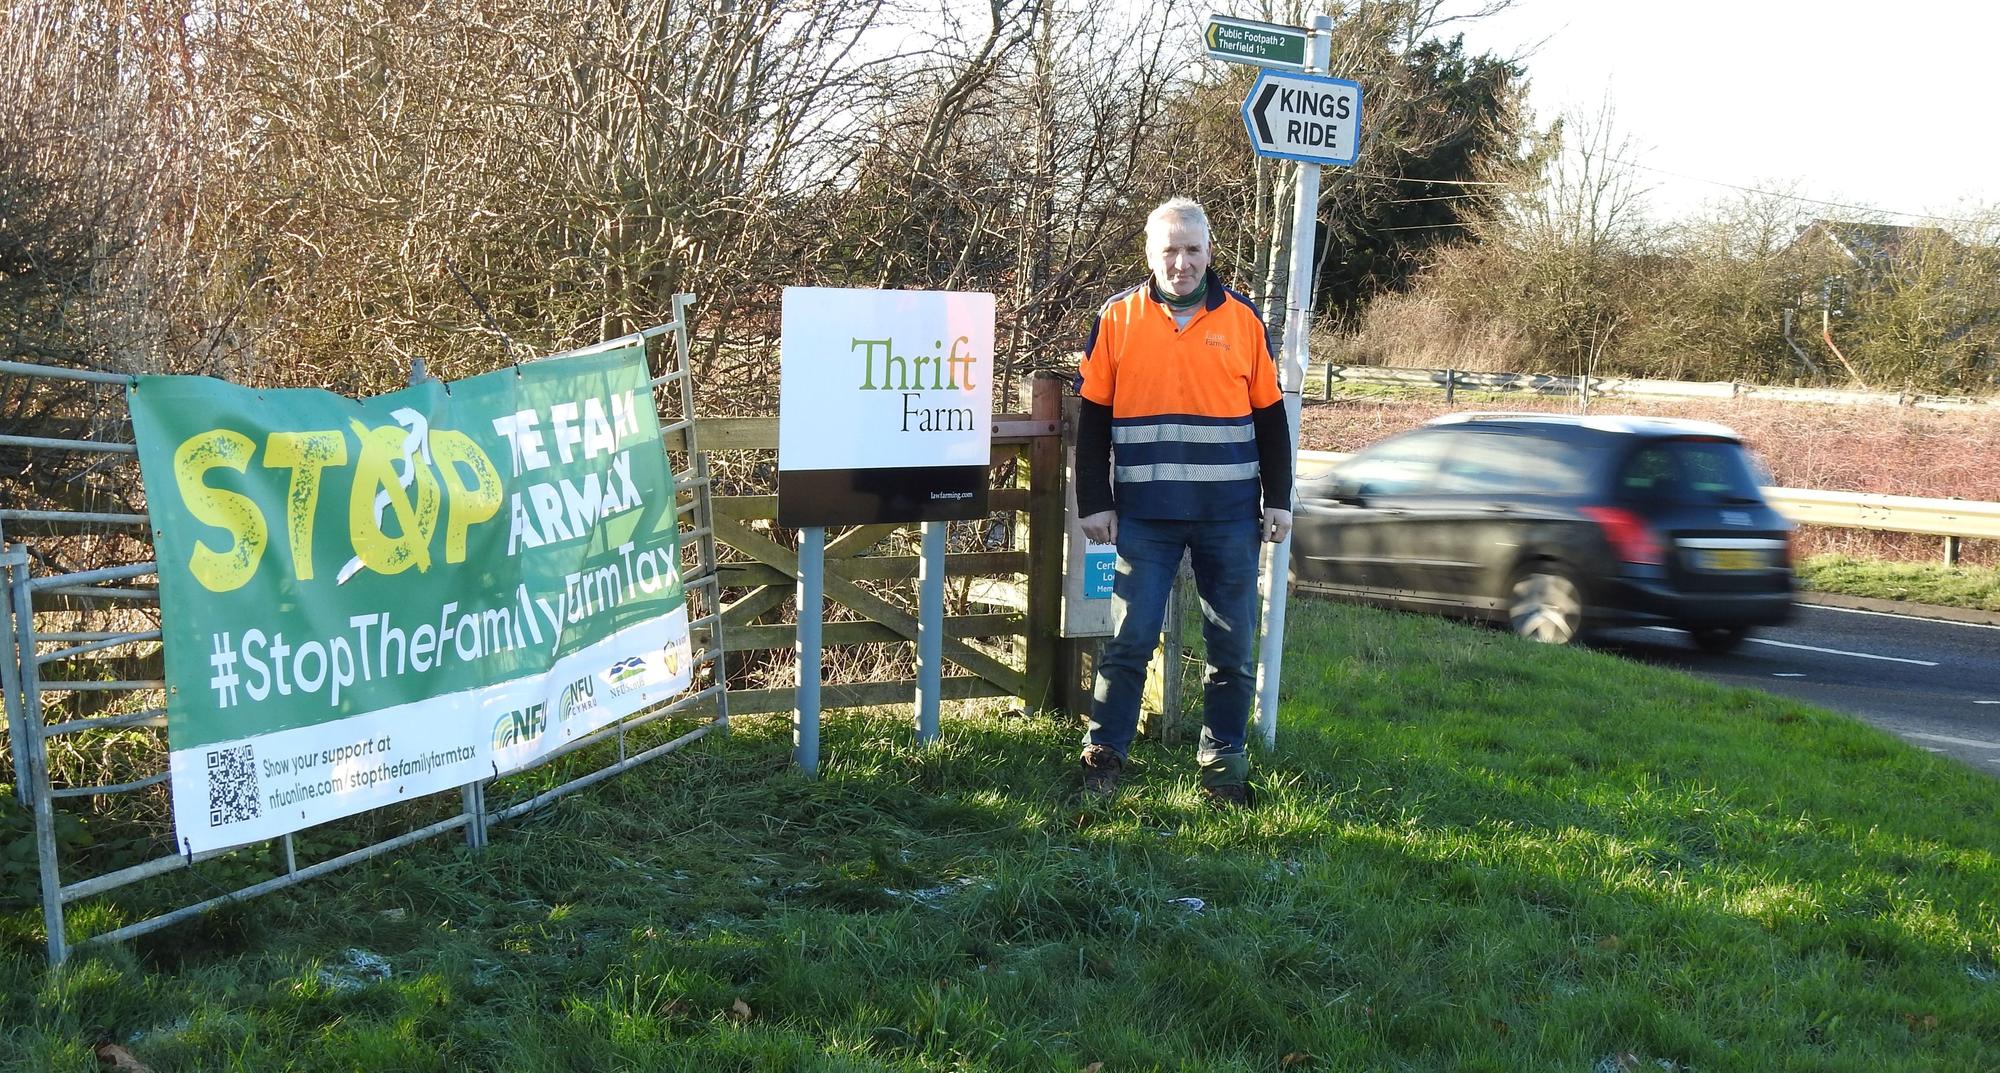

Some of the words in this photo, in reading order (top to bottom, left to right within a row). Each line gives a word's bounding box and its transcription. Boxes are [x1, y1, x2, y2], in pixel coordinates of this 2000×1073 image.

[1219, 26, 1243, 40] Public
[1244, 31, 1278, 45] Footpath
[1279, 36, 1286, 47] 2
[1219, 38, 1254, 53] Therfield
[1279, 87, 1350, 120] KINGS
[1286, 120, 1338, 148] RIDE
[851, 335, 977, 392] Thrift
[900, 393, 975, 432] Farm
[173, 416, 503, 592] STOP
[930, 491, 974, 501] lawfarming.com
[511, 698, 548, 745] NFU
[570, 675, 594, 706] NFU
[572, 698, 598, 716] CYMRU
[263, 756, 289, 778] Show
[291, 751, 319, 776] your
[321, 738, 374, 766] support
[377, 735, 392, 752] at
